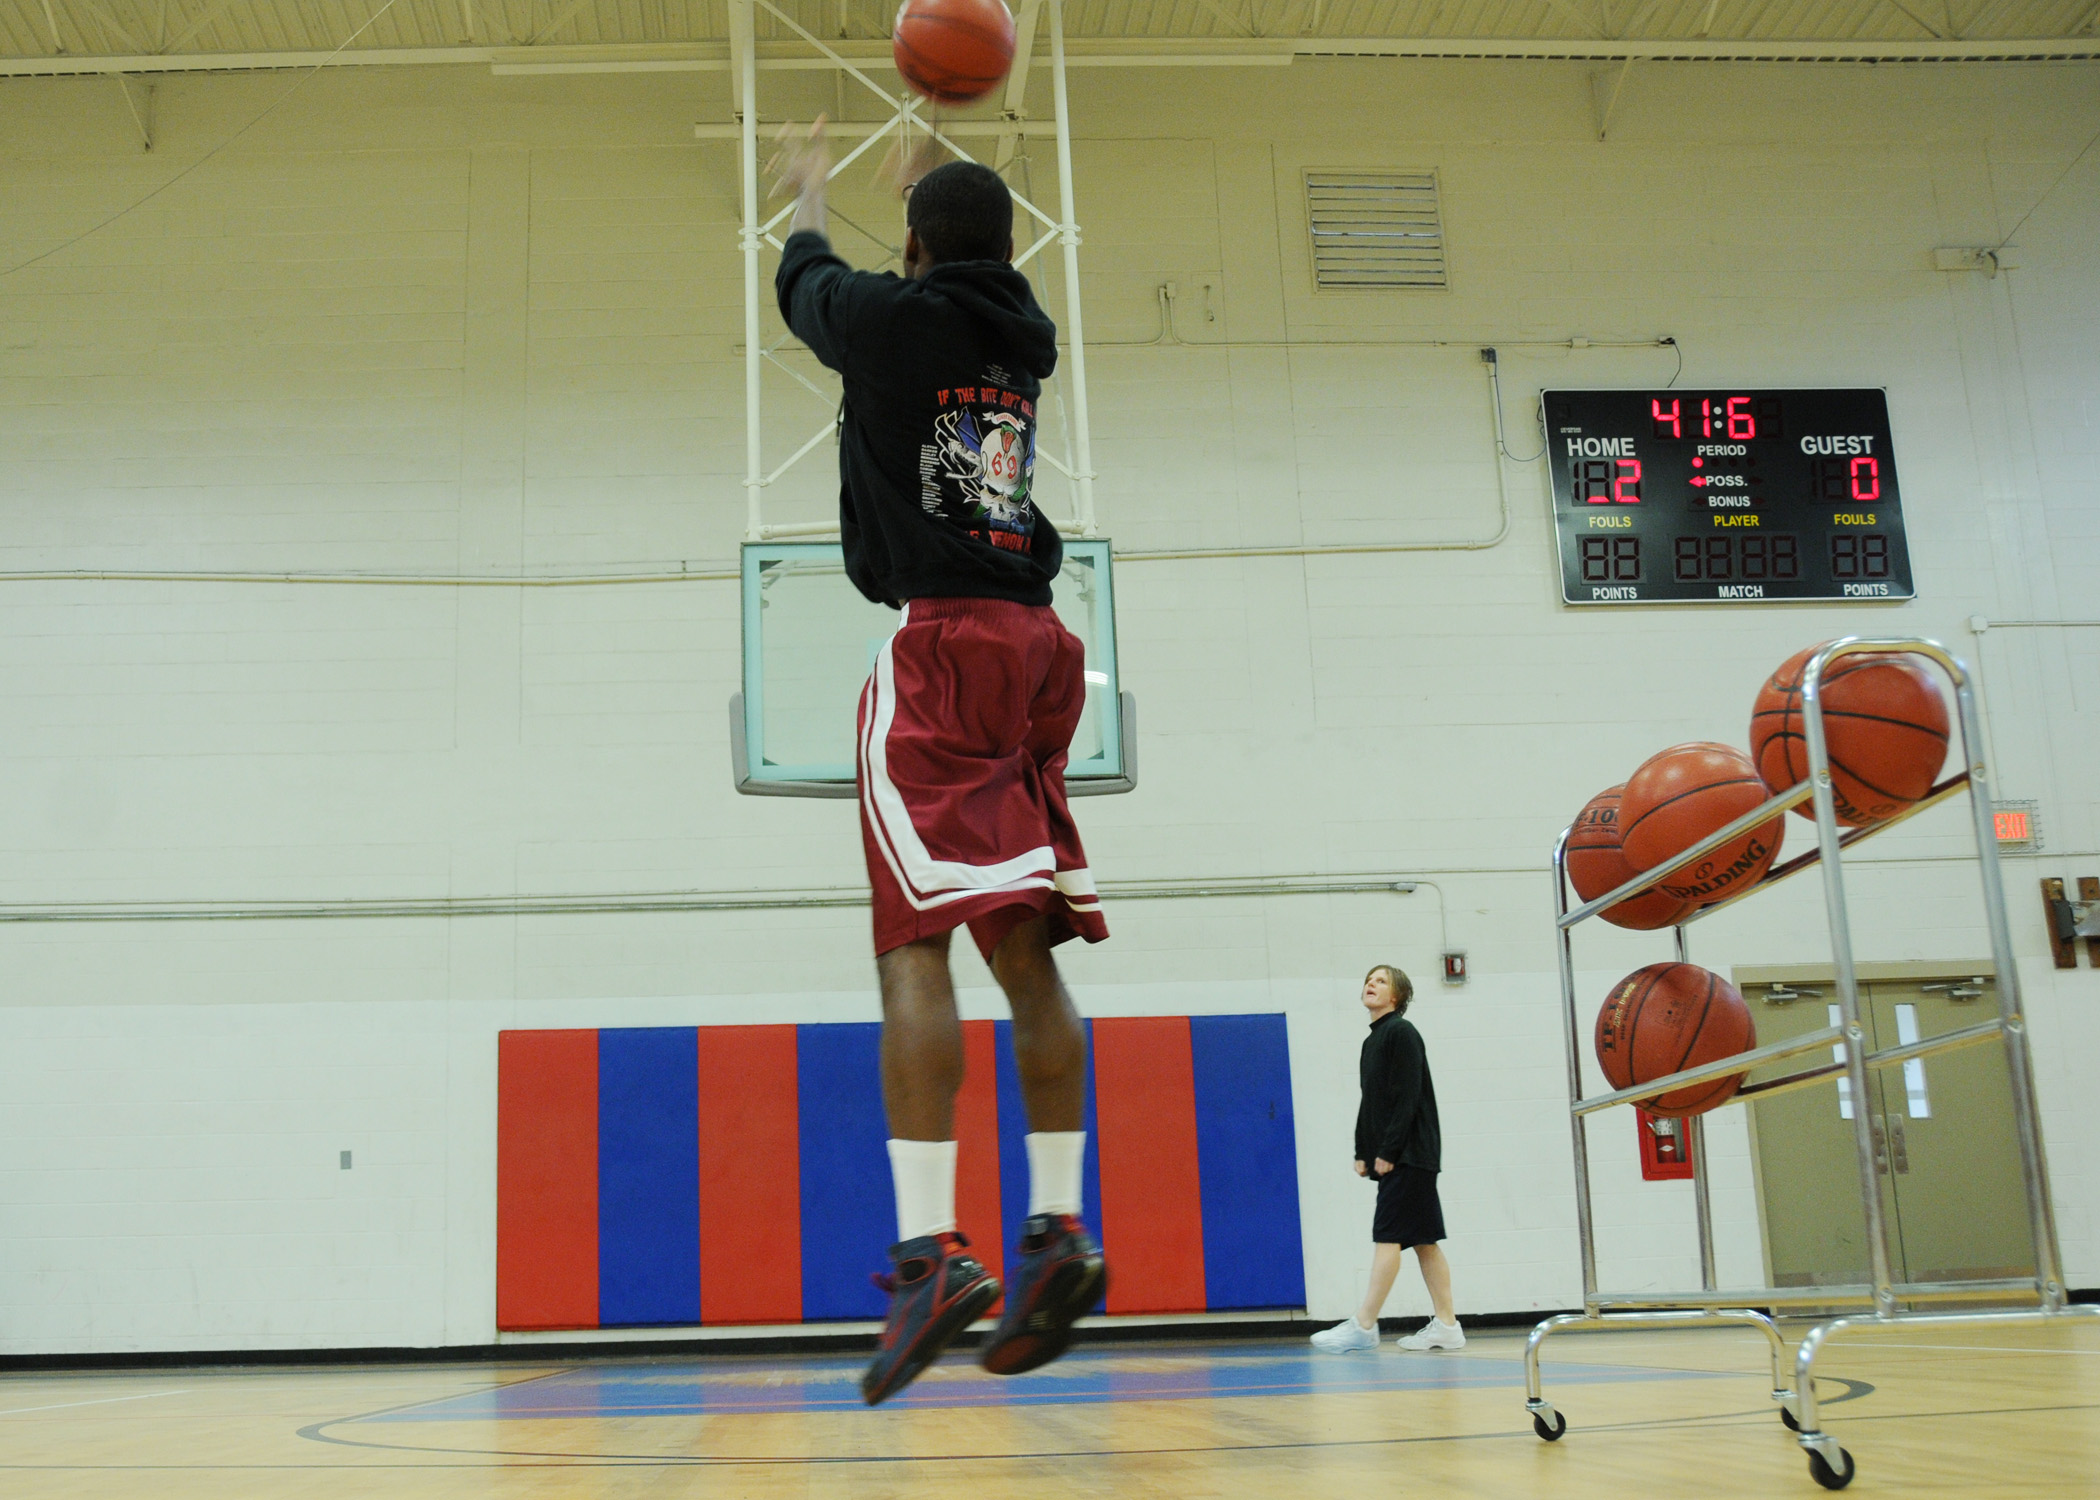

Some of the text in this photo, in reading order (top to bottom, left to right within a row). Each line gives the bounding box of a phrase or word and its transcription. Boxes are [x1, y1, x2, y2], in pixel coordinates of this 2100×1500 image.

[937, 389, 949, 406] IF
[955, 387, 976, 405] THE
[980, 387, 998, 404] BITE
[1566, 437, 1636, 457] HOME
[1697, 445, 1747, 456] PERIOD
[1800, 435, 1874, 455] GUEST
[1705, 475, 1748, 487] POSS.
[1708, 495, 1751, 507] BONUS
[1588, 516, 1632, 528] FOULS
[1713, 515, 1760, 527] PLAYER
[1833, 513, 1876, 525] FOULS
[1592, 587, 1638, 600] POINTS
[1718, 585, 1763, 598] MATCH
[1843, 583, 1889, 596] POINTS
[1992, 812, 2028, 840] EXIT
